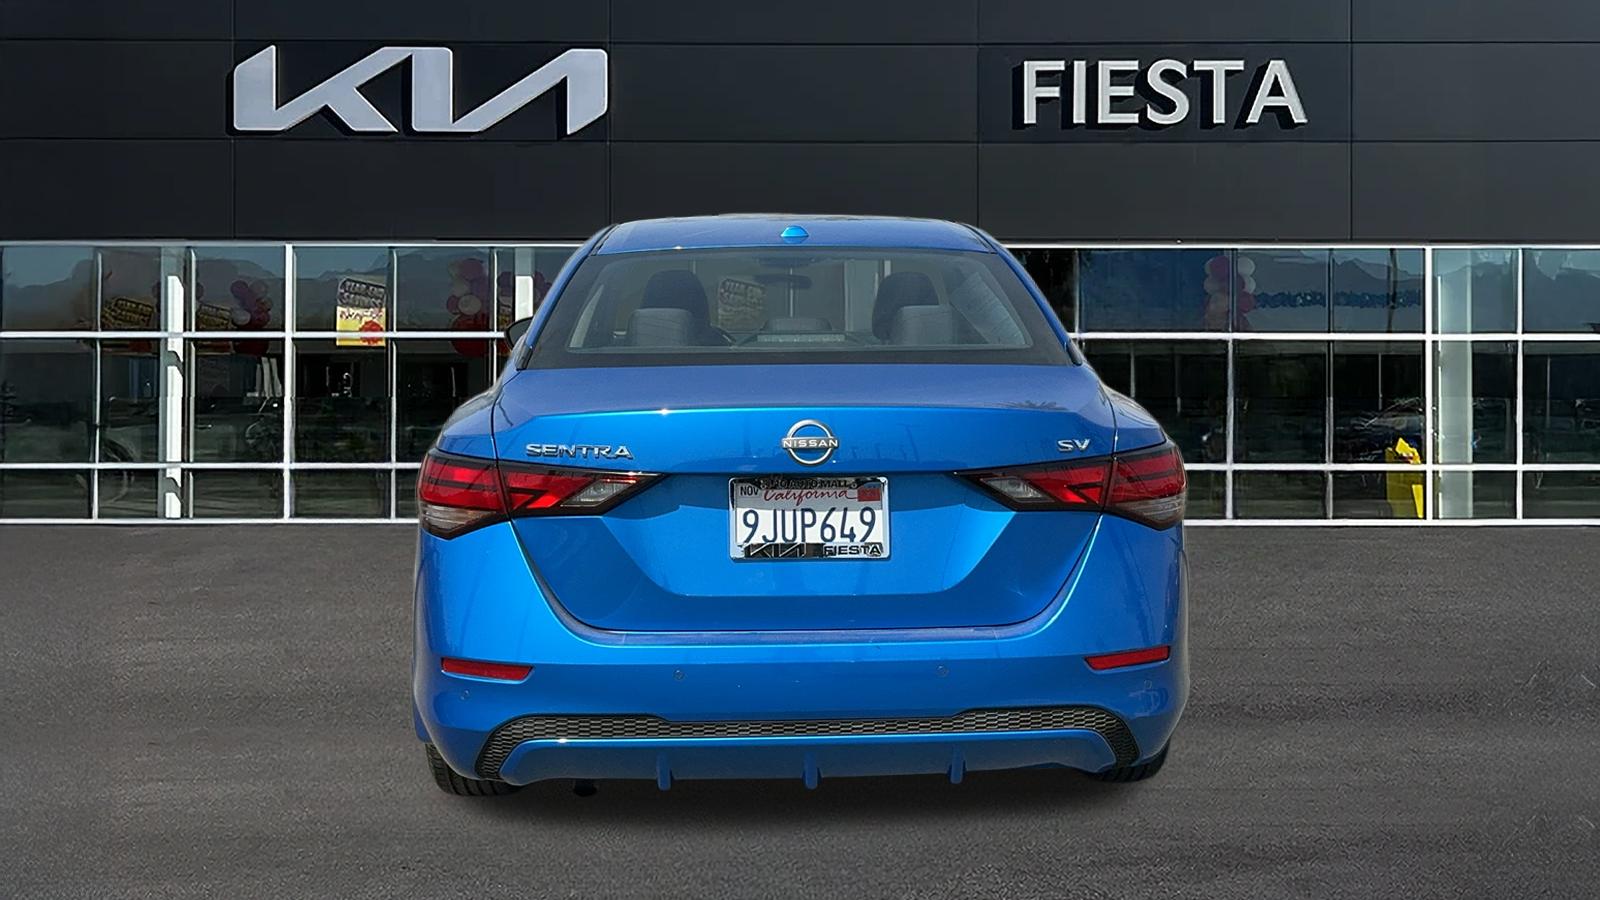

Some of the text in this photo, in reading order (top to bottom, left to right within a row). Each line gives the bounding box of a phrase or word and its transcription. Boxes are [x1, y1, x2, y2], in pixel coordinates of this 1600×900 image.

[1023, 58, 1308, 125] FIESTA
[783, 439, 838, 448] NISSAN
[1057, 439, 1091, 451] SV
[526, 443, 633, 460] SENTRA
[820, 479, 849, 488] MALL
[740, 485, 759, 496] NOV
[763, 489, 850, 506] California
[742, 507, 877, 543] 9JUP649
[824, 544, 882, 556] FIESTA
